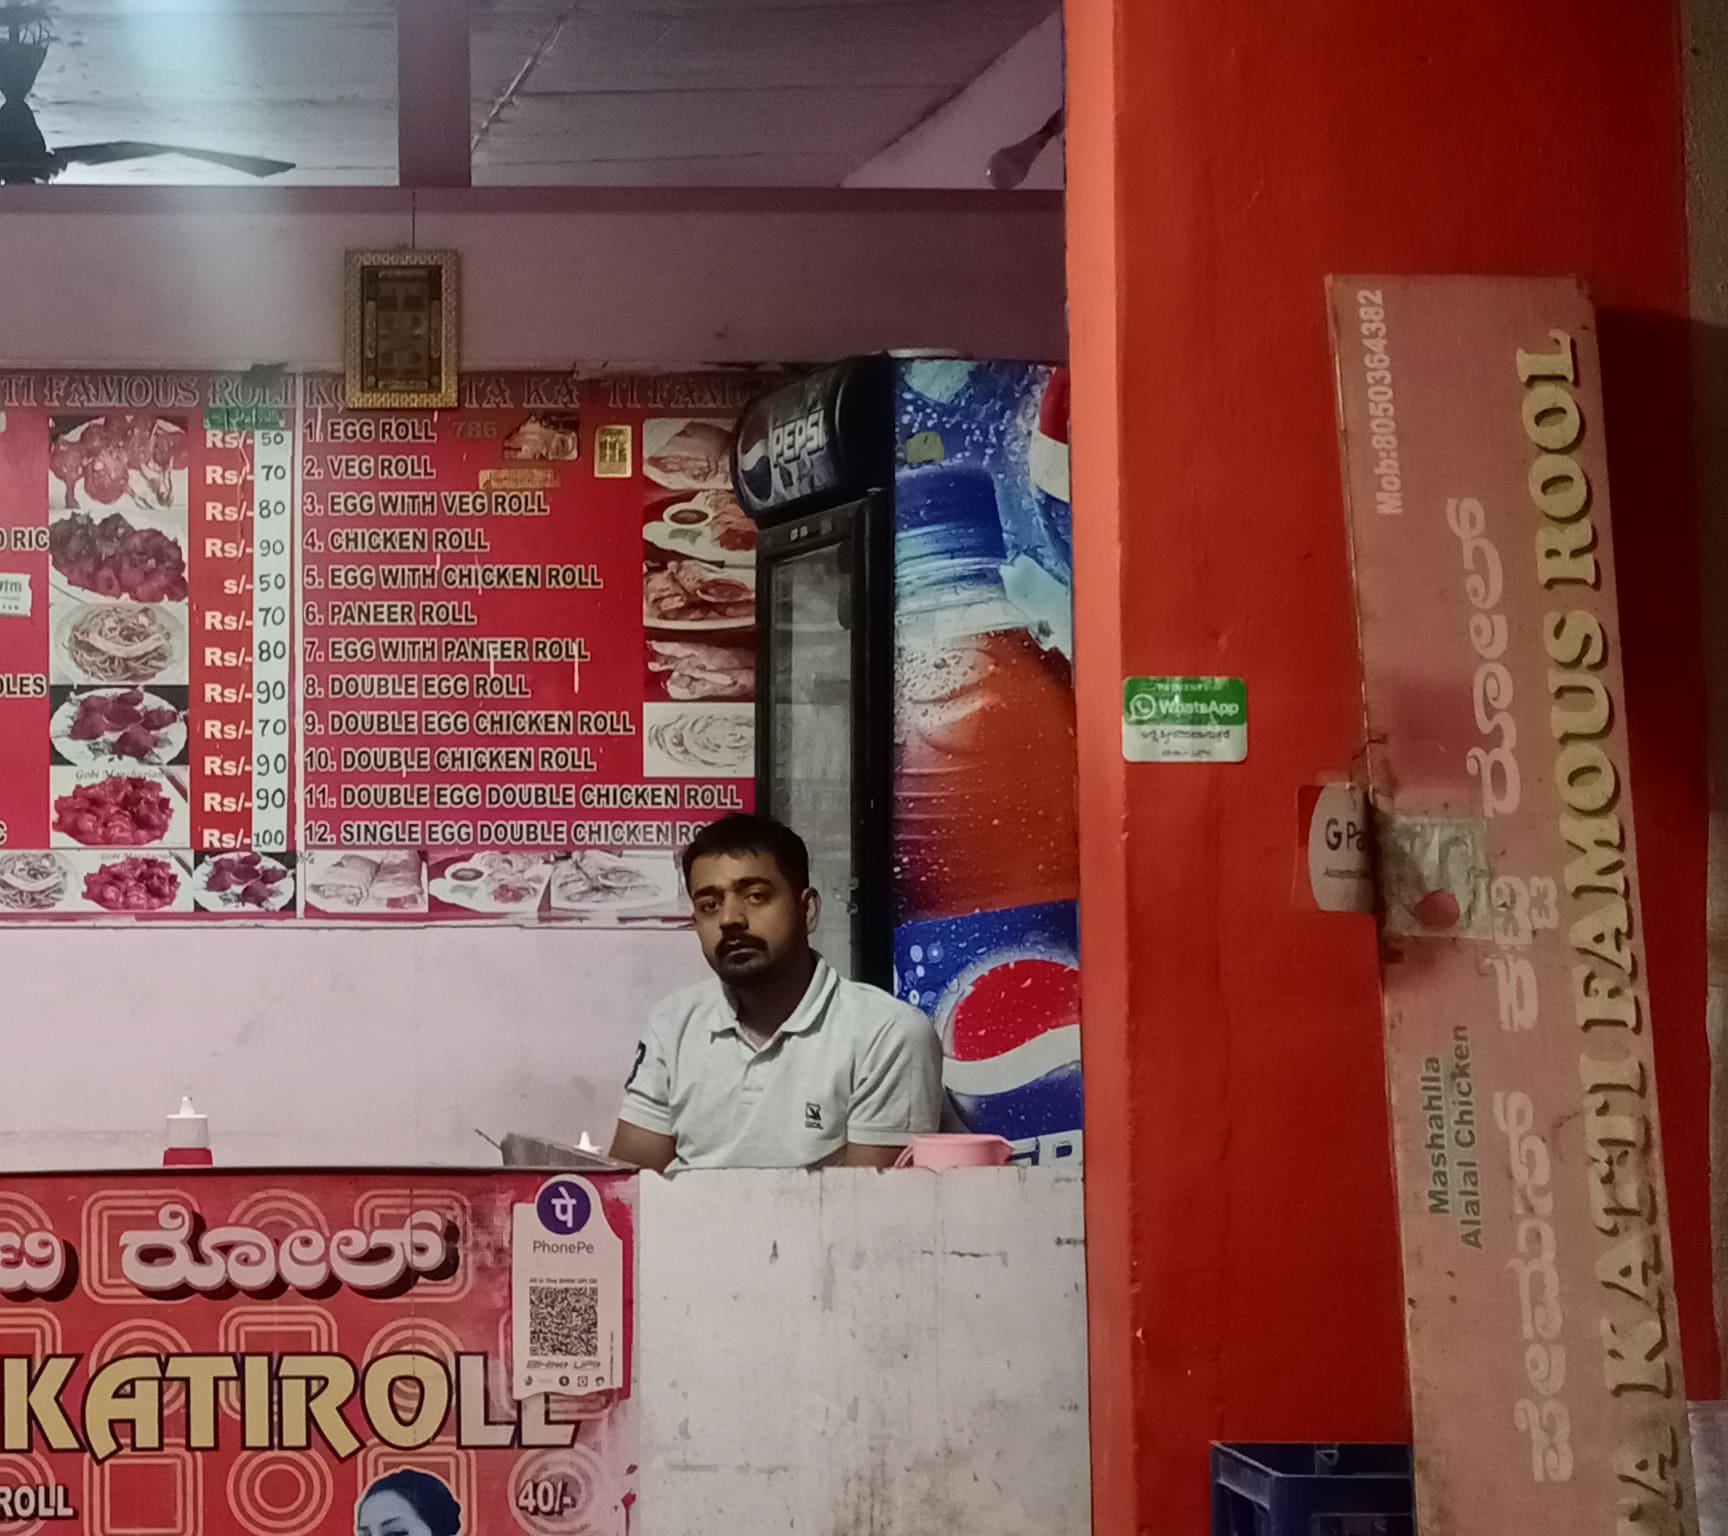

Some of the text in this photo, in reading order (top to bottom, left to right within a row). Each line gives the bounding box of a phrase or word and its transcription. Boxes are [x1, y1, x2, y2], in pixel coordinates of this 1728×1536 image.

[44, 376, 200, 408] FAMOUS
[261, 432, 284, 446] 50
[328, 419, 373, 442] EGG
[379, 419, 437, 442] ROLL
[772, 408, 828, 465] PEPSI
[261, 465, 286, 480] 70
[1516, 328, 1602, 592] ROOL
[328, 529, 428, 552] CHICKEN
[434, 529, 490, 552] ROLL
[329, 601, 416, 625] PANEER
[420, 601, 477, 625] ROLL
[329, 712, 416, 735] DOUBLE
[423, 712, 468, 735] EGG
[474, 711, 572, 734] CHICKEN
[578, 711, 635, 735] ROLL
[253, 831, 284, 847] 100
[1543, 610, 1642, 1036] FAMOUS
[1419, 1055, 1451, 1216] Mashahlla
[1452, 1024, 1484, 1249] Alalal Chicken
[1579, 1052, 1675, 1398] KATTI
[118, 1203, 452, 1294] ರೋಲ್
[532, 1241, 594, 1254] PhonePe
[518, 1483, 576, 1515] 40/-
